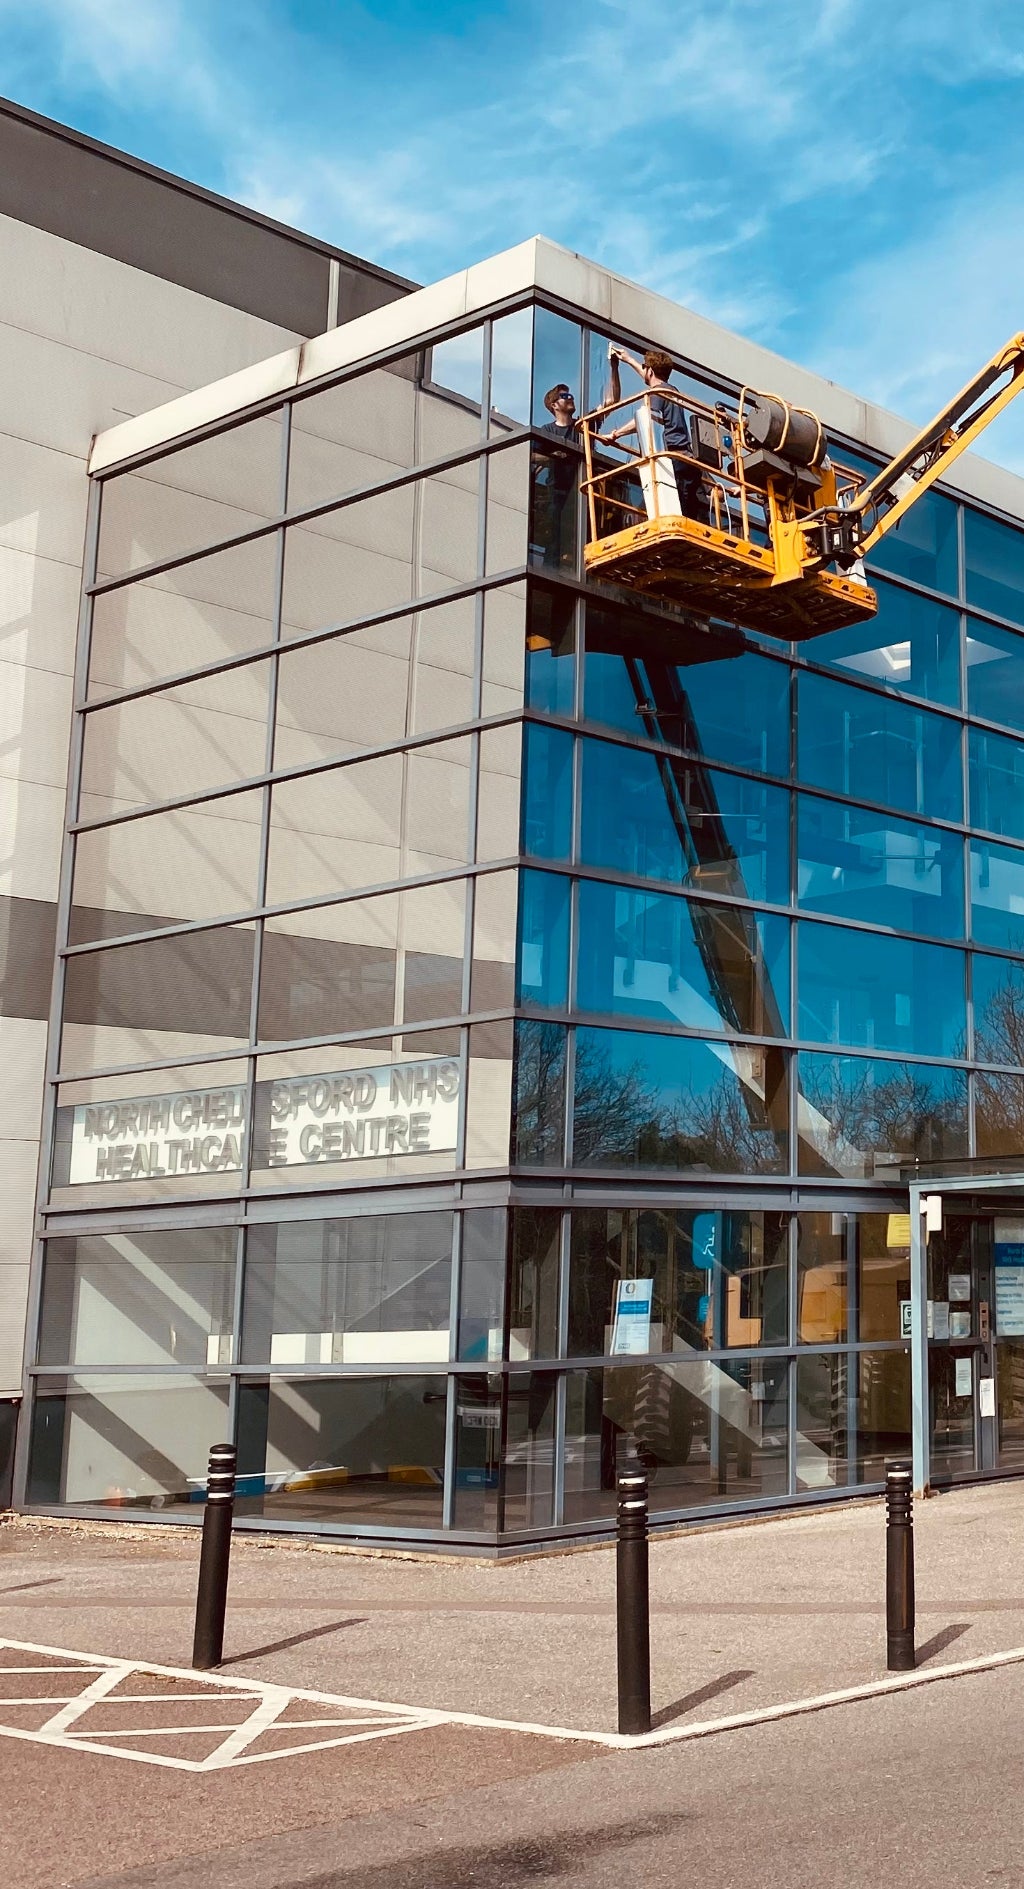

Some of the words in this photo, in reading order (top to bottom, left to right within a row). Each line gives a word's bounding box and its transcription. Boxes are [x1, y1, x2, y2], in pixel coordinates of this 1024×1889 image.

[84, 1098, 171, 1141] NORTH
[173, 1073, 378, 1131] CHELSFORD
[389, 1061, 460, 1106] NHS
[96, 1127, 289, 1179] HEALTHCAE
[299, 1112, 431, 1161] CENTRE
